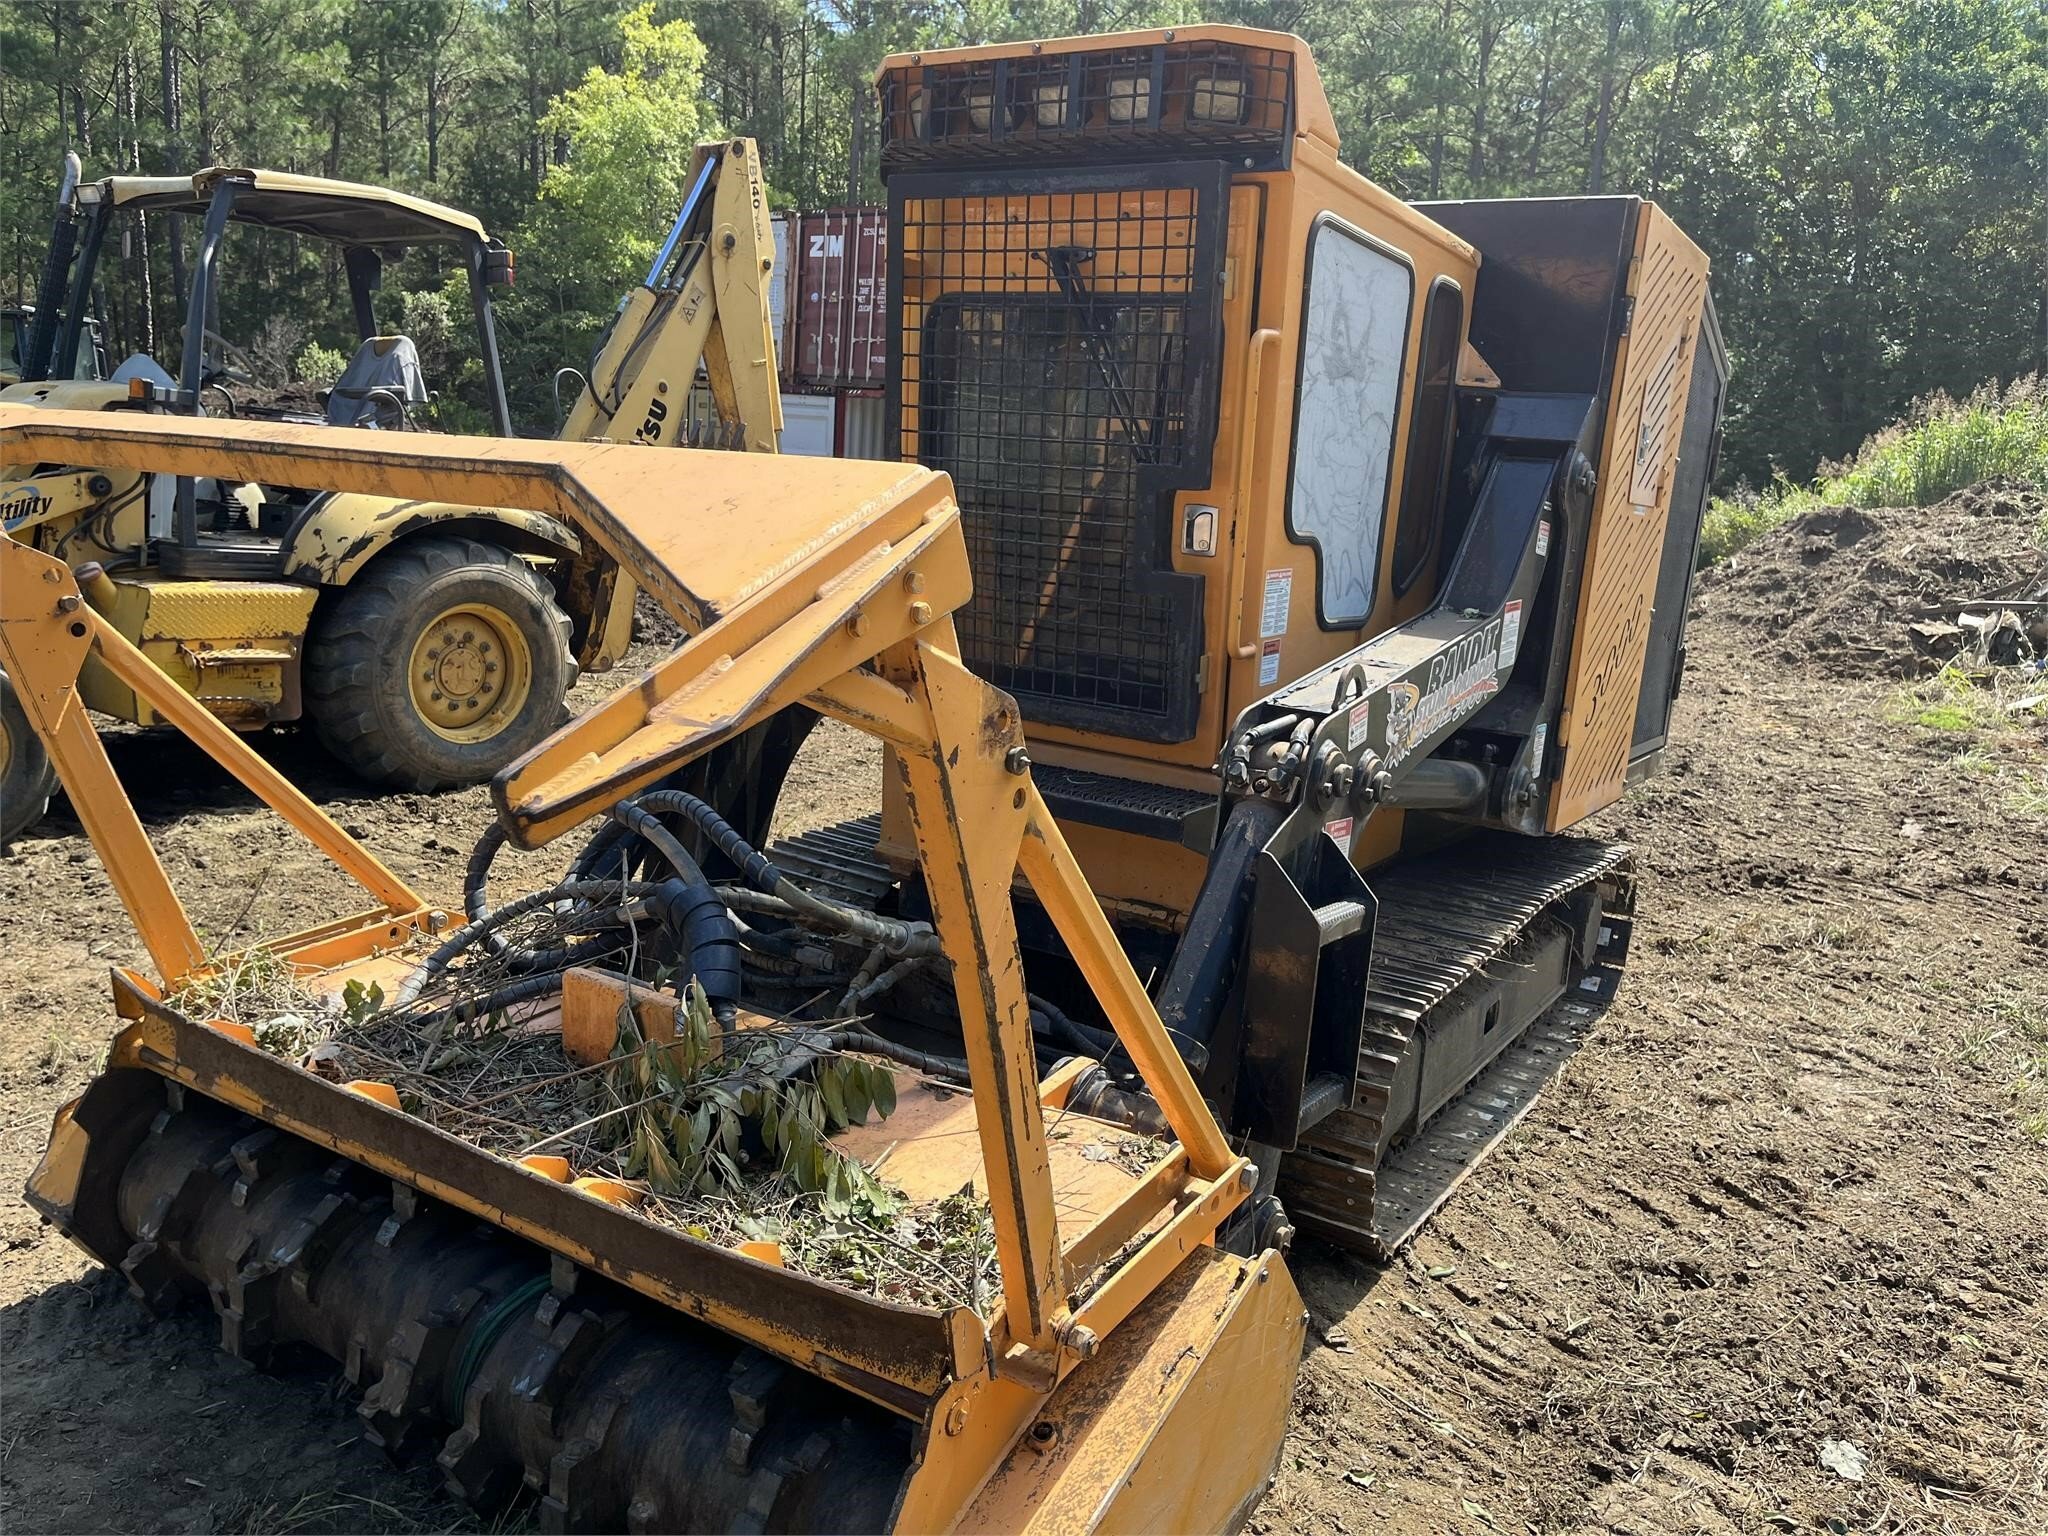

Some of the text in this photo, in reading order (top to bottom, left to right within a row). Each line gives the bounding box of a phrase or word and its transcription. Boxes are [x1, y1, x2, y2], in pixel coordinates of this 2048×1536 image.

[809, 235, 845, 258] ZIM
[0, 496, 53, 521] tility
[1426, 618, 1501, 697] BANDIT
[1584, 593, 1644, 728] 3000
